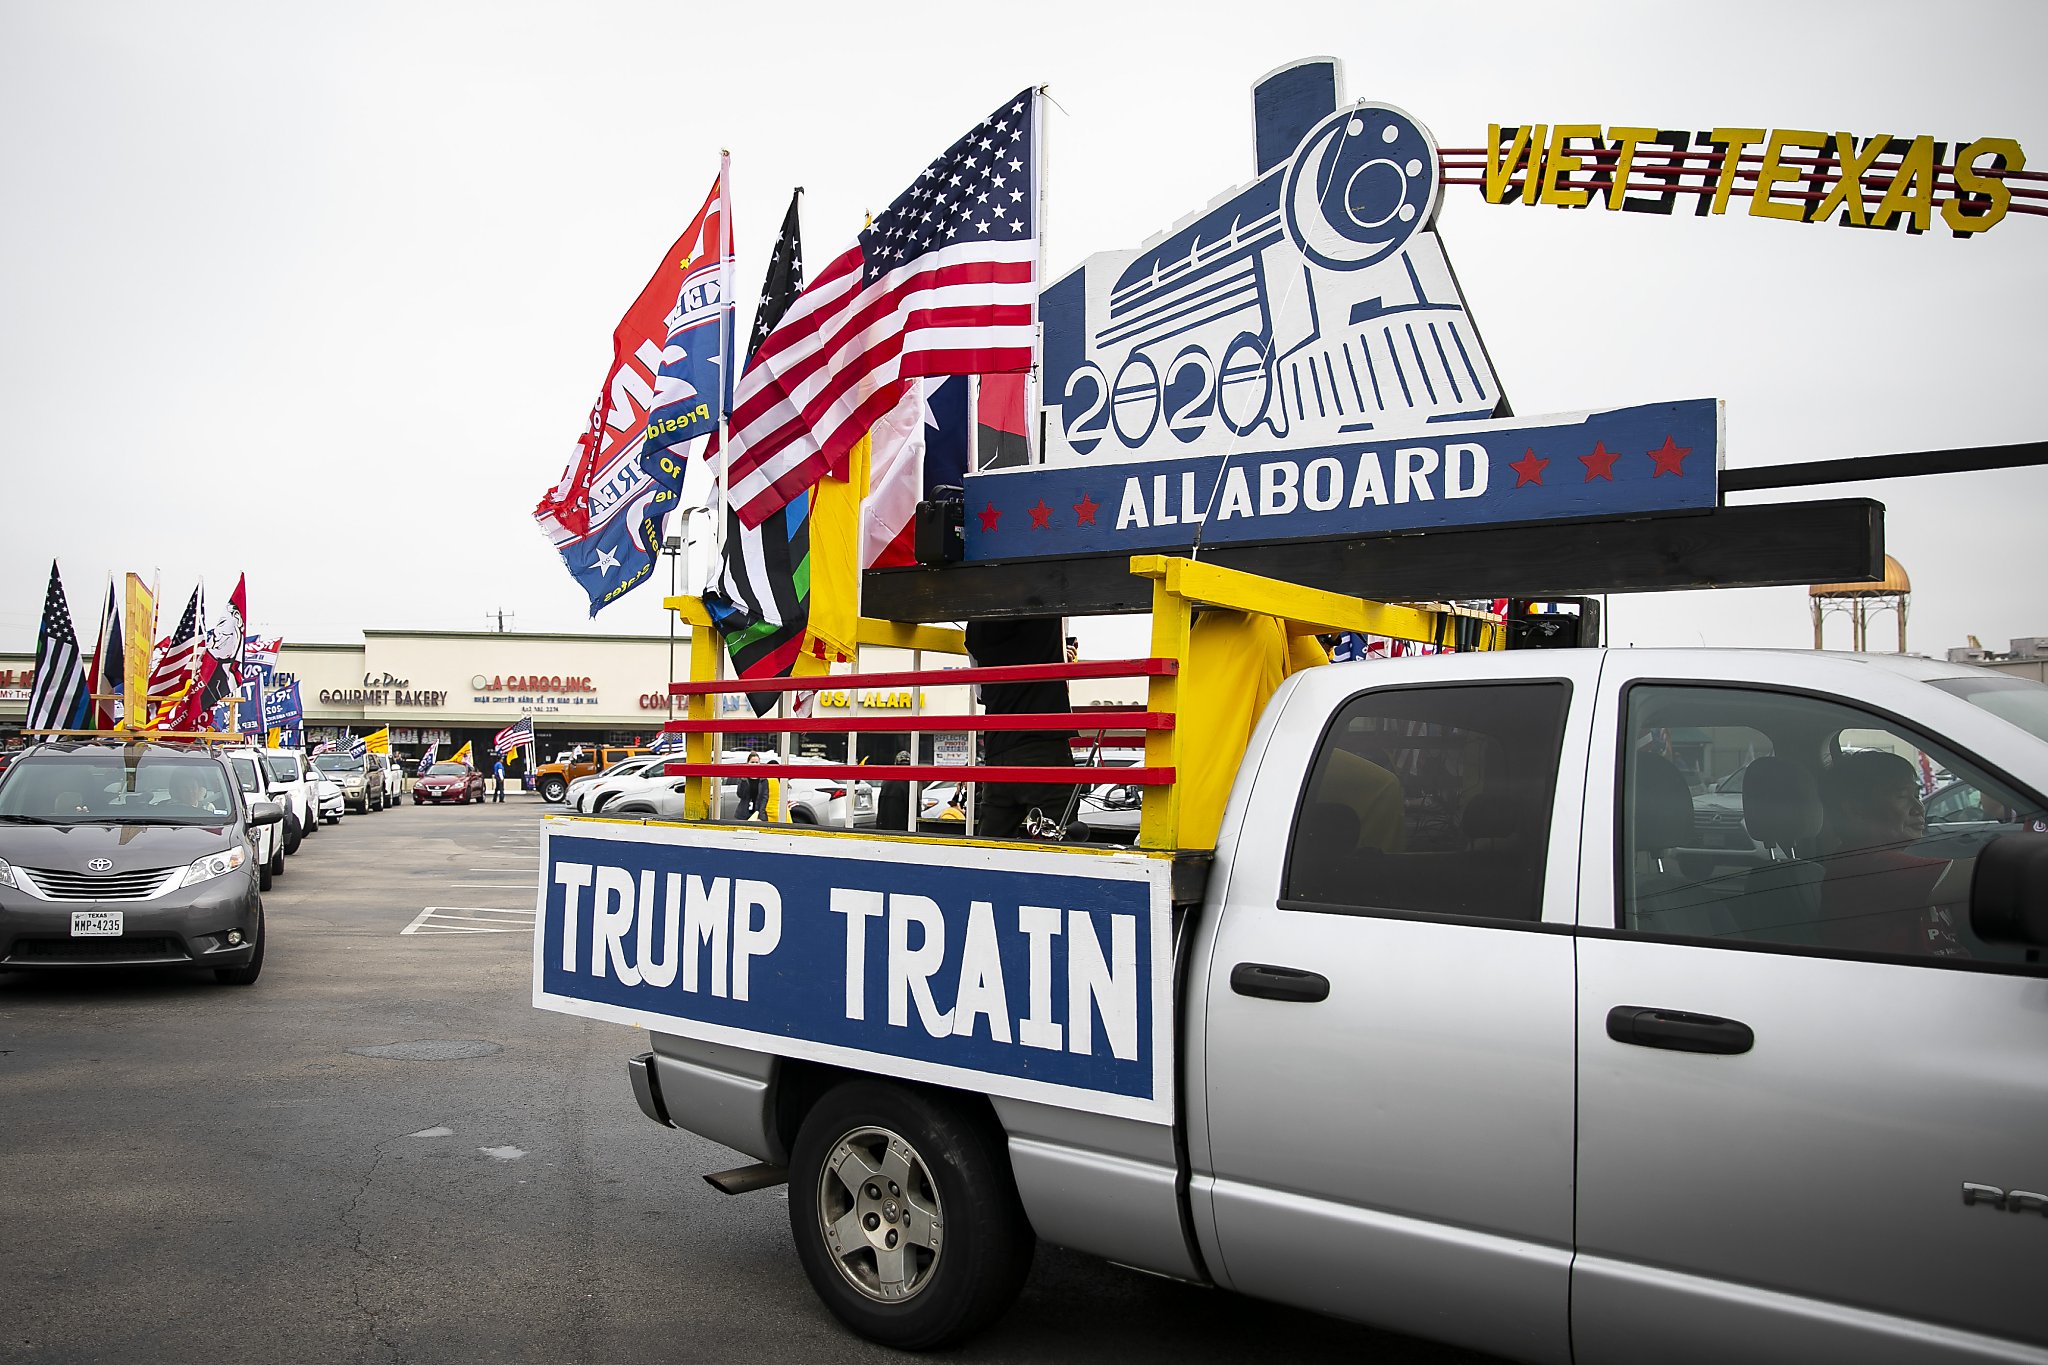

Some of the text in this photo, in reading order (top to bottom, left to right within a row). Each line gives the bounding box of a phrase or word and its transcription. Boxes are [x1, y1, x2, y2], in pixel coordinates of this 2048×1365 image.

[1486, 123, 2028, 234] VIET TEXAS
[1115, 441, 1490, 531] ALL ABOARD
[319, 689, 448, 707] GOURMET BAKERY
[555, 861, 1139, 1061] TRUMP TRAIN
